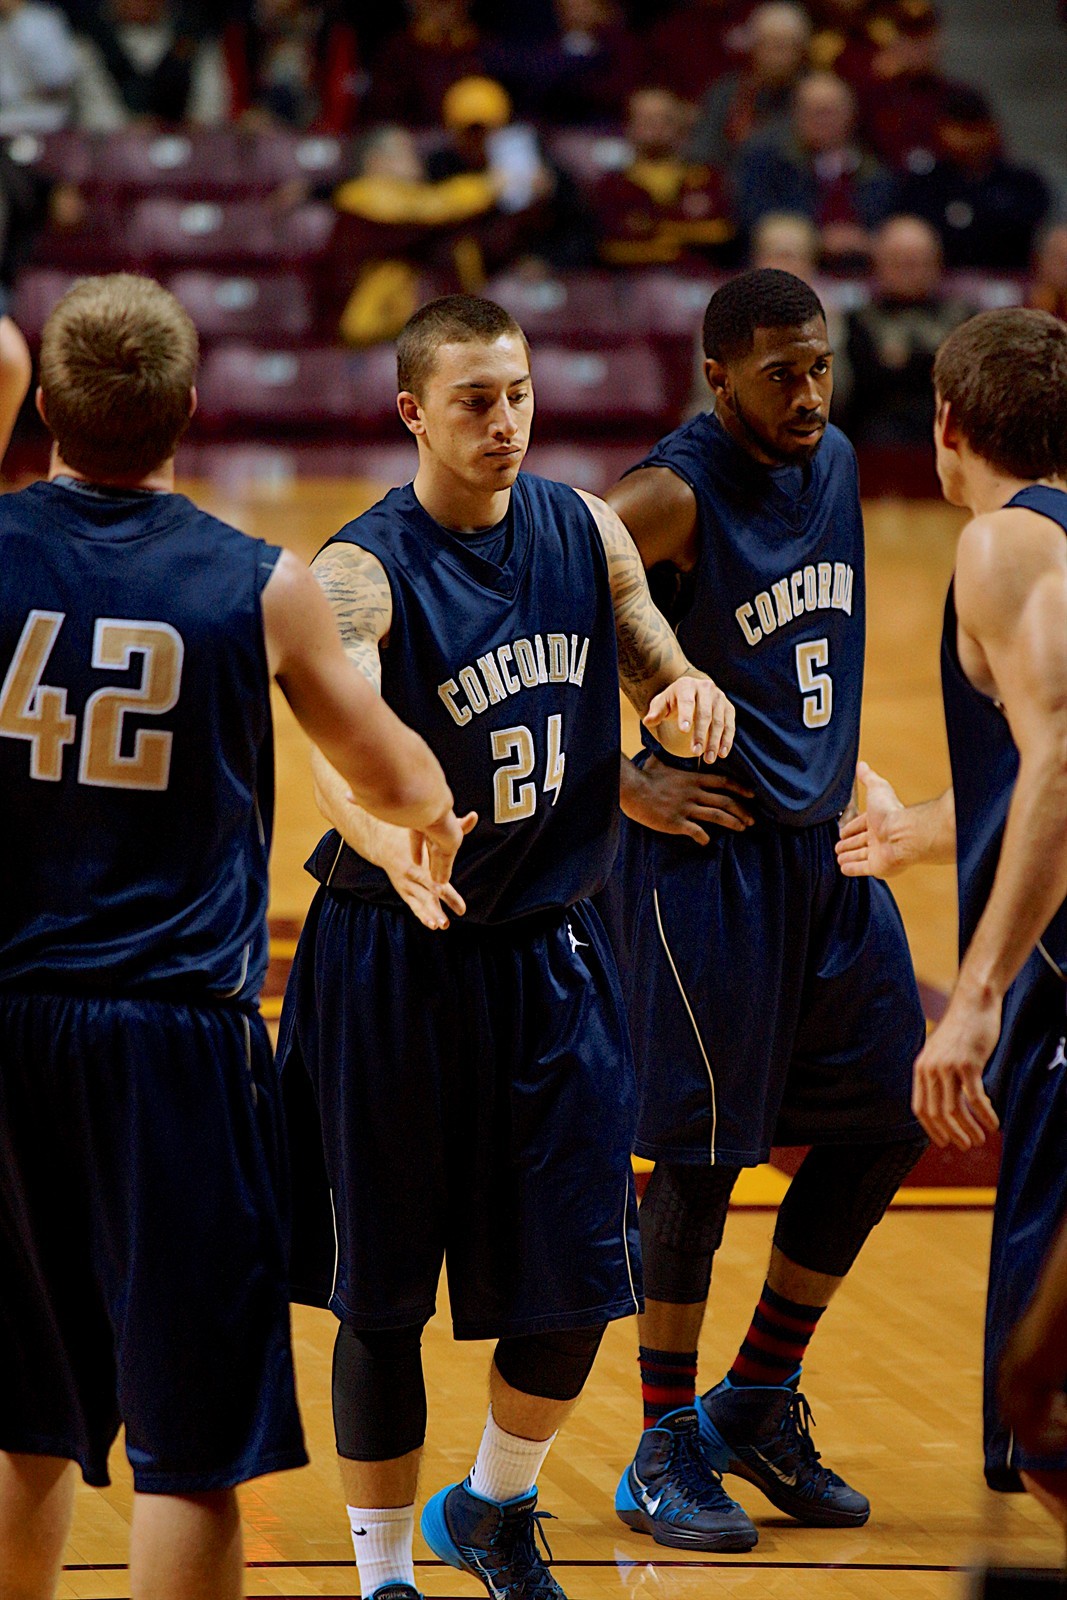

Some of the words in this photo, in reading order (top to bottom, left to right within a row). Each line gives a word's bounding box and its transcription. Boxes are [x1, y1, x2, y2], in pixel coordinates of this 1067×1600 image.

[0, 609, 184, 791] 42
[795, 637, 833, 729] 5
[490, 713, 565, 824] 24
